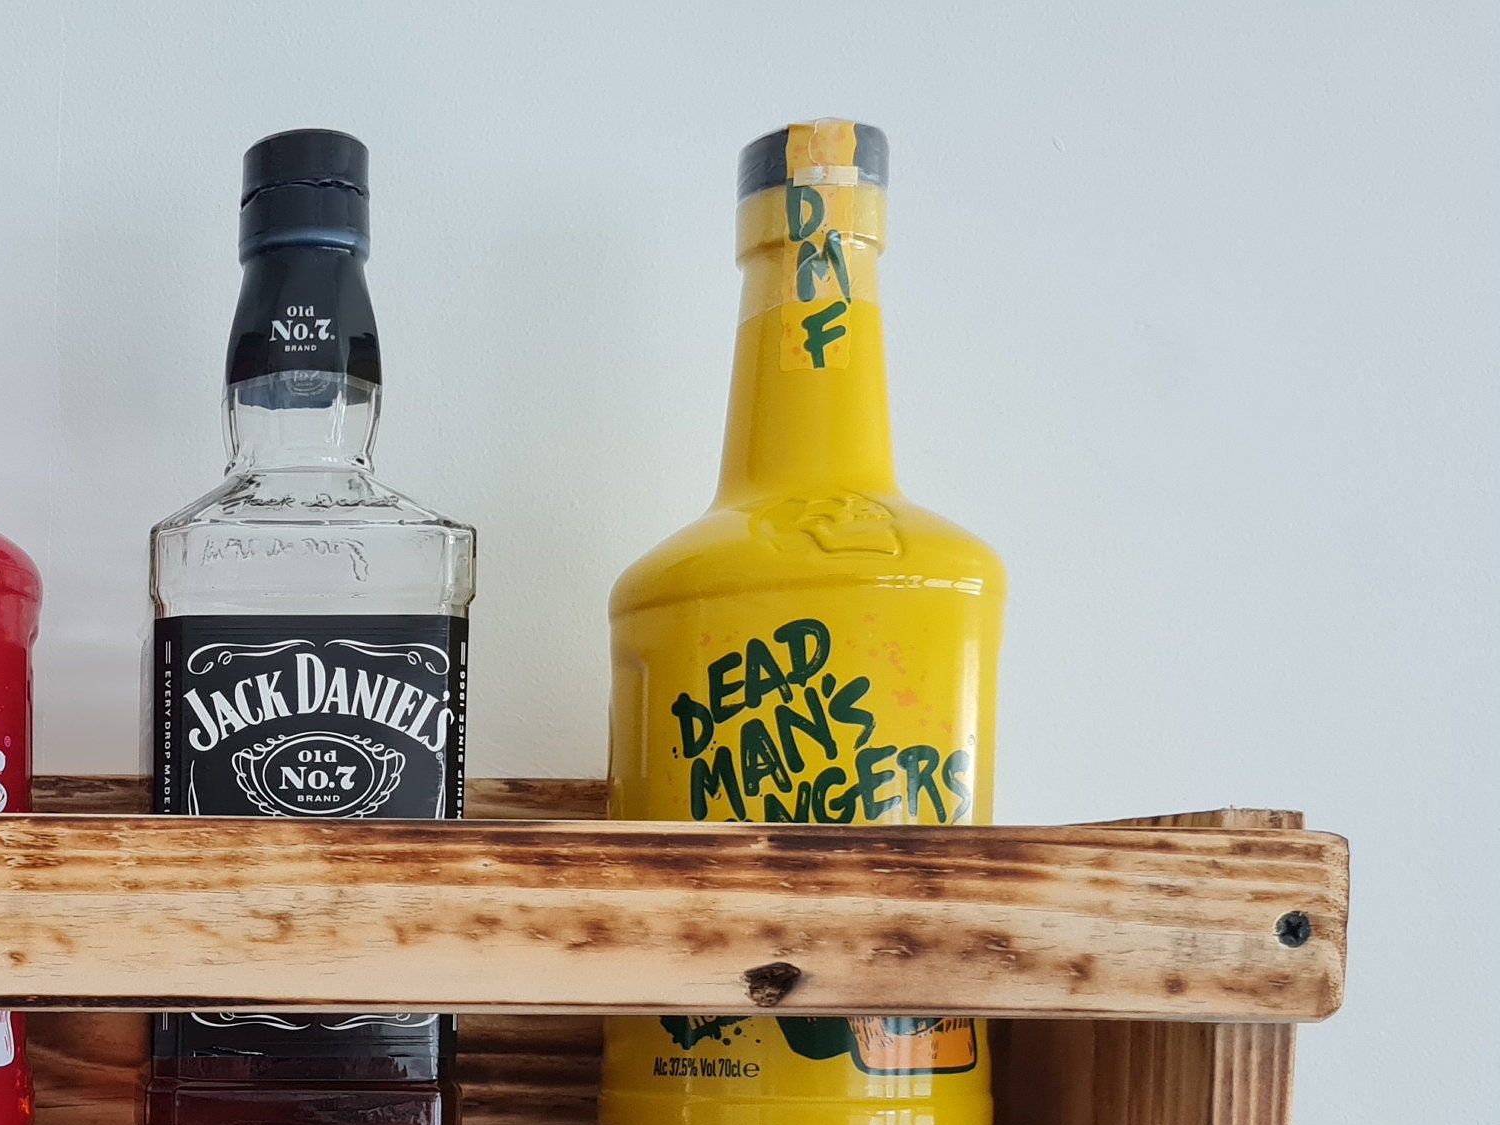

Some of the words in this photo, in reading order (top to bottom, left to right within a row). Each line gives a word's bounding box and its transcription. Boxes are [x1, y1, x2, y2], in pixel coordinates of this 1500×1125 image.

[286, 305, 315, 317] Old
[284, 344, 317, 352] BRAND
[164, 670, 172, 717] EVERY
[183, 669, 293, 752] JACK
[295, 652, 456, 753] DANIEL'S
[671, 618, 832, 759] DEAD
[298, 749, 338, 762] Old
[690, 673, 877, 821] MAN'S
[163, 764, 171, 804] MADE
[297, 794, 341, 802] BRAND
[653, 1057, 667, 1076] Alc
[669, 1057, 698, 1077] 37.5%
[700, 1058, 716, 1077] Vol
